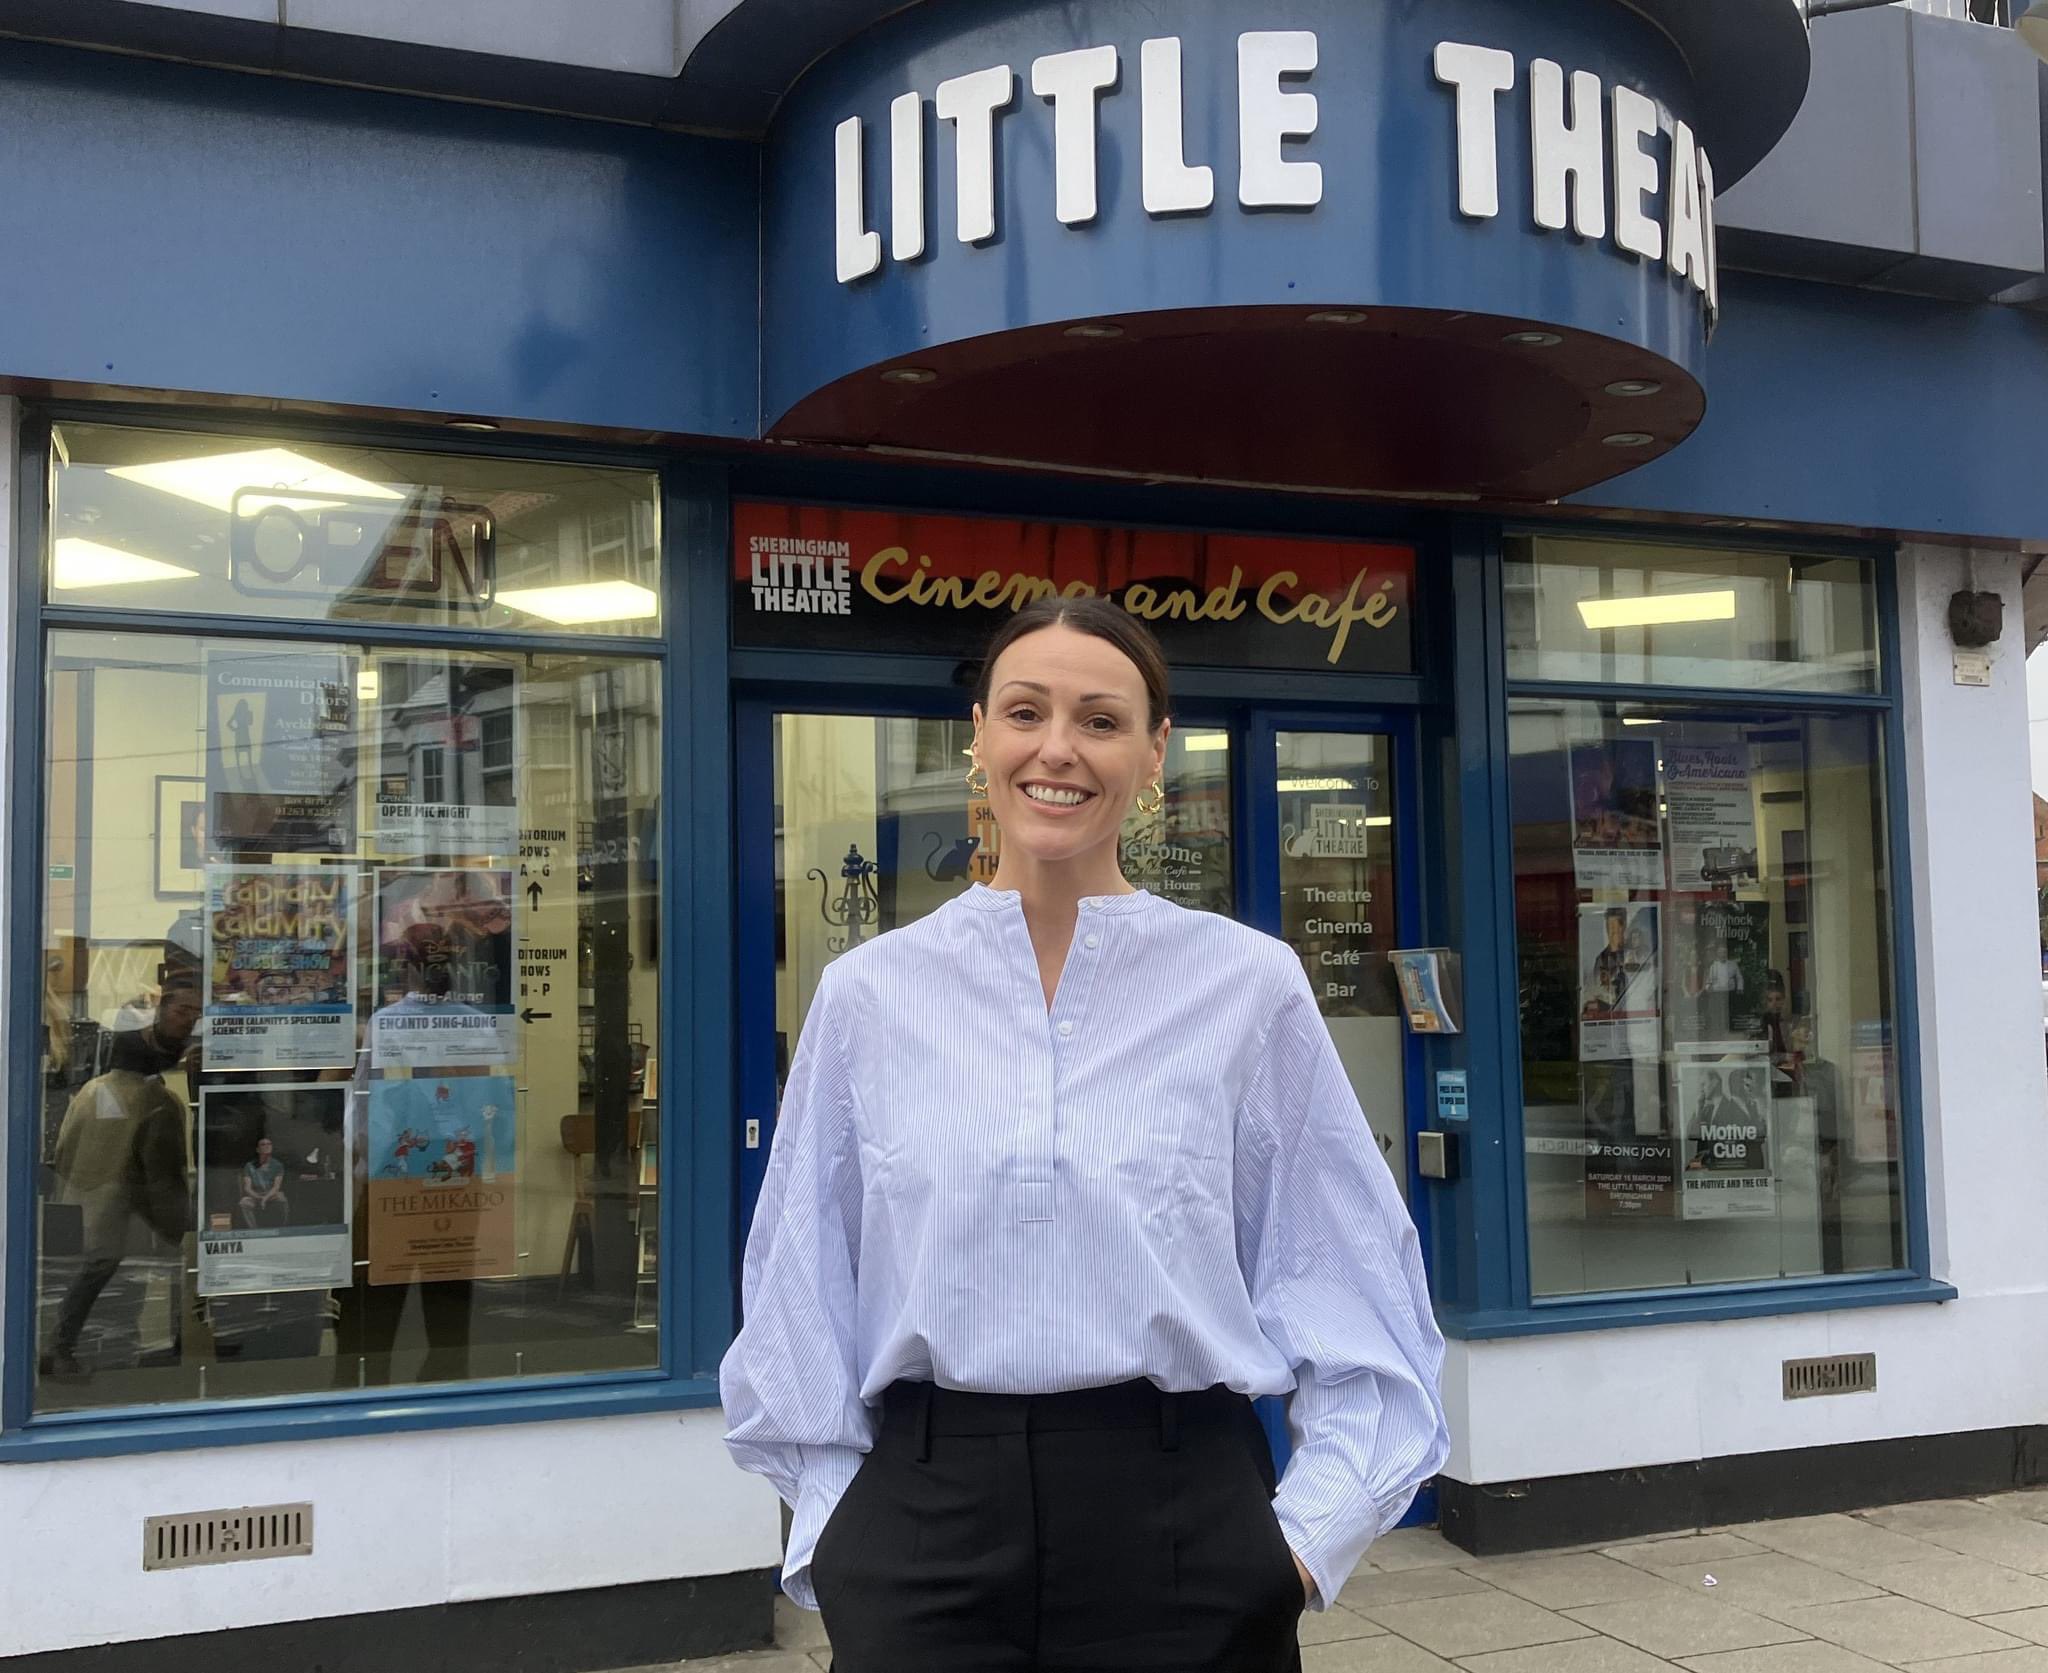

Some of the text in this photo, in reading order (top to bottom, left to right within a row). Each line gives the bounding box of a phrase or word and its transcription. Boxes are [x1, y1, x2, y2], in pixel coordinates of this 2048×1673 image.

[835, 30, 1322, 284] LITTLE
[750, 536, 849, 556] SHERINGHAM
[751, 552, 850, 590] LITTLE
[751, 587, 851, 615] THEATRE
[1124, 565, 1247, 620] and
[1256, 567, 1397, 664] Café
[218, 672, 349, 695] Communicating
[1364, 777, 1379, 790] To
[381, 805, 471, 819] OPEN MIC NIGHT
[1316, 818, 1363, 838] LITTLE
[520, 846, 550, 857] ROWS
[1316, 840, 1364, 854] THEATRE
[521, 863, 528, 877] A
[542, 863, 551, 877] G
[1163, 879, 1200, 891] Hours
[1303, 887, 1372, 903] Theatre
[1304, 917, 1373, 934] Cinema
[1700, 911, 1753, 928] Hollyhock
[1715, 926, 1750, 941] Trilogy
[1319, 949, 1361, 966] Café
[520, 965, 551, 977] ROWS
[542, 983, 551, 997] P
[1326, 982, 1358, 998] Bar
[212, 1016, 245, 1026] CAPTAIN
[291, 1015, 341, 1025] SPECTACULAR
[379, 1015, 497, 1030] ENCANTO SING-ALONG
[212, 1026, 269, 1036] SCIENCE SHOW
[1700, 1123, 1757, 1141] Motive
[1587, 1143, 1671, 1161] WRONG JOVI
[1713, 1142, 1747, 1158] Cue
[1588, 1173, 1621, 1182] SATURDAY
[1632, 1174, 1656, 1182] MARCH
[1686, 1178, 1768, 1189] THE MOTIVE AND THE CUE
[1598, 1182, 1664, 1191] THE LITTLE THEATRE
[378, 1192, 505, 1212] THE MIKADO
[205, 1241, 244, 1255] VANYA
